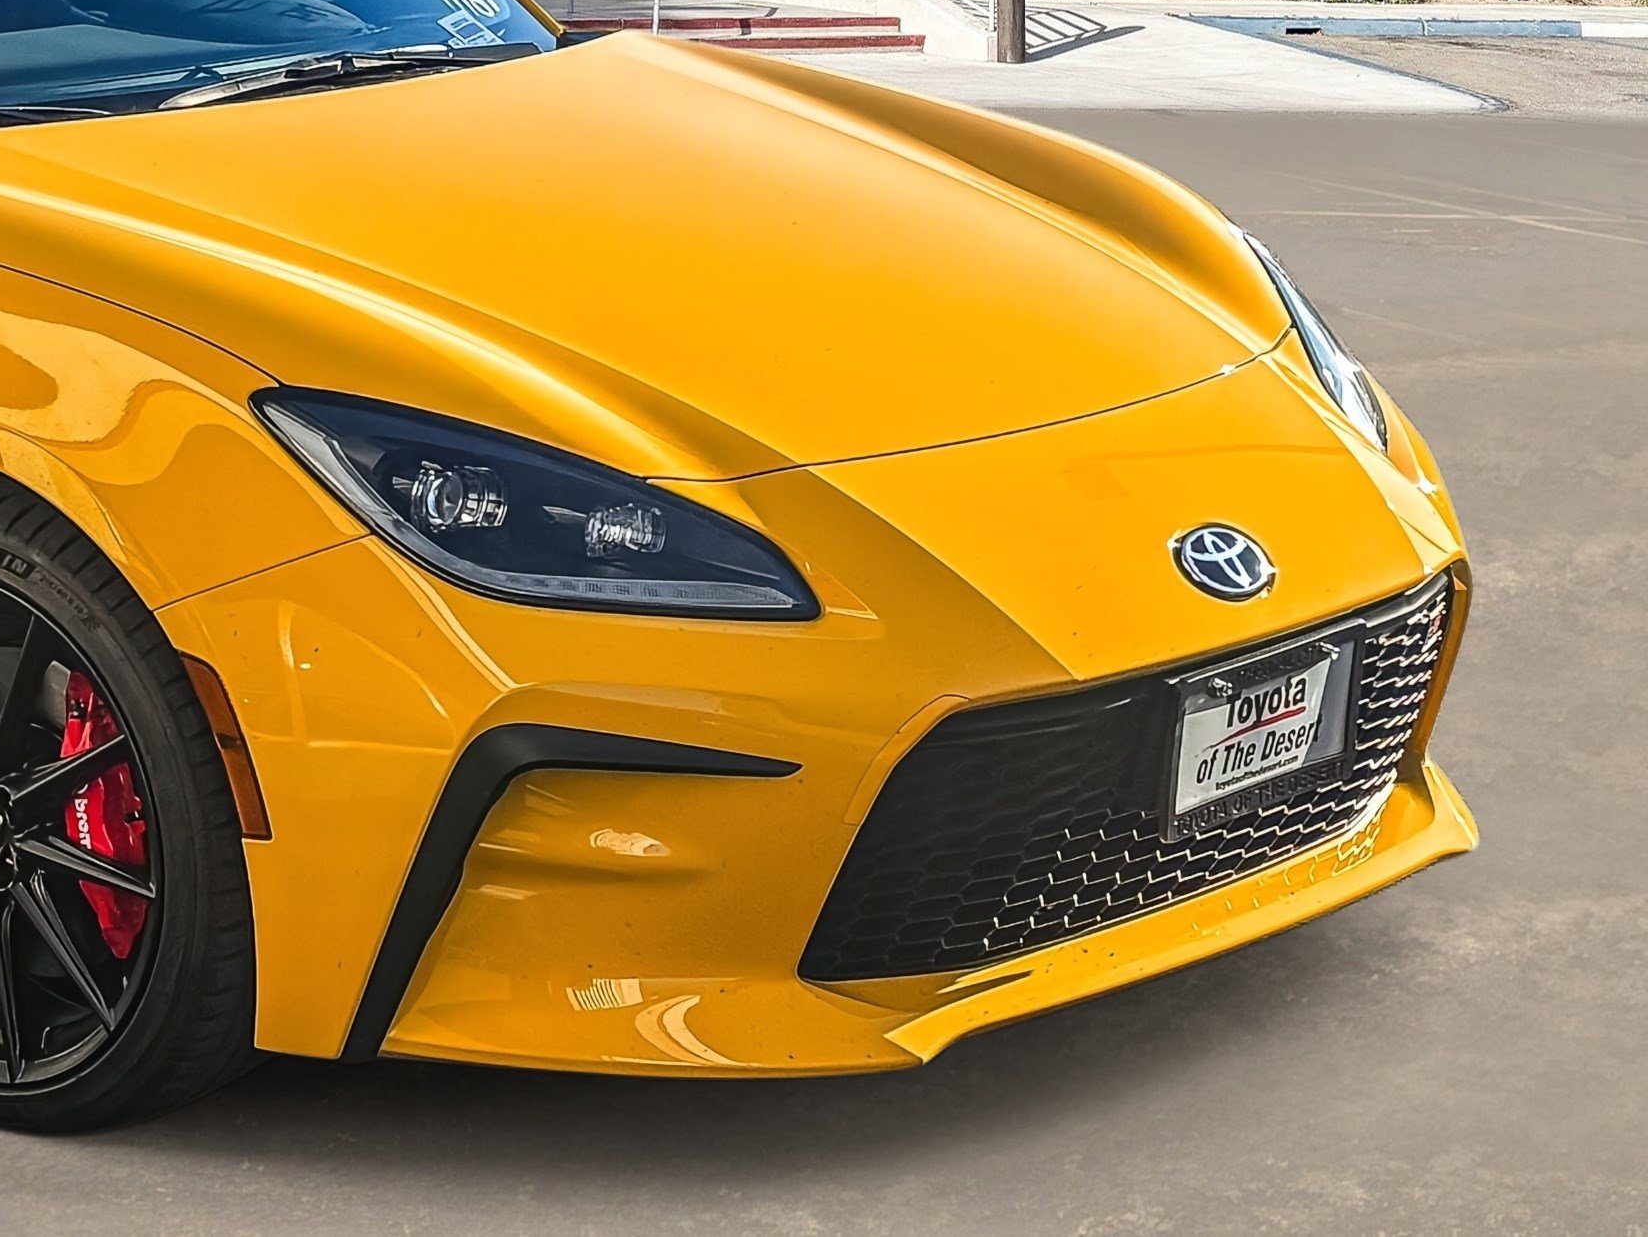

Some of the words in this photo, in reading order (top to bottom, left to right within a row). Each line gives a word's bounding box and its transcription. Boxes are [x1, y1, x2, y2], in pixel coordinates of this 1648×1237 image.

[1226, 674, 1307, 729] Toyota
[1196, 748, 1219, 785] of
[1221, 740, 1257, 775] The
[1260, 713, 1322, 762] Desert
